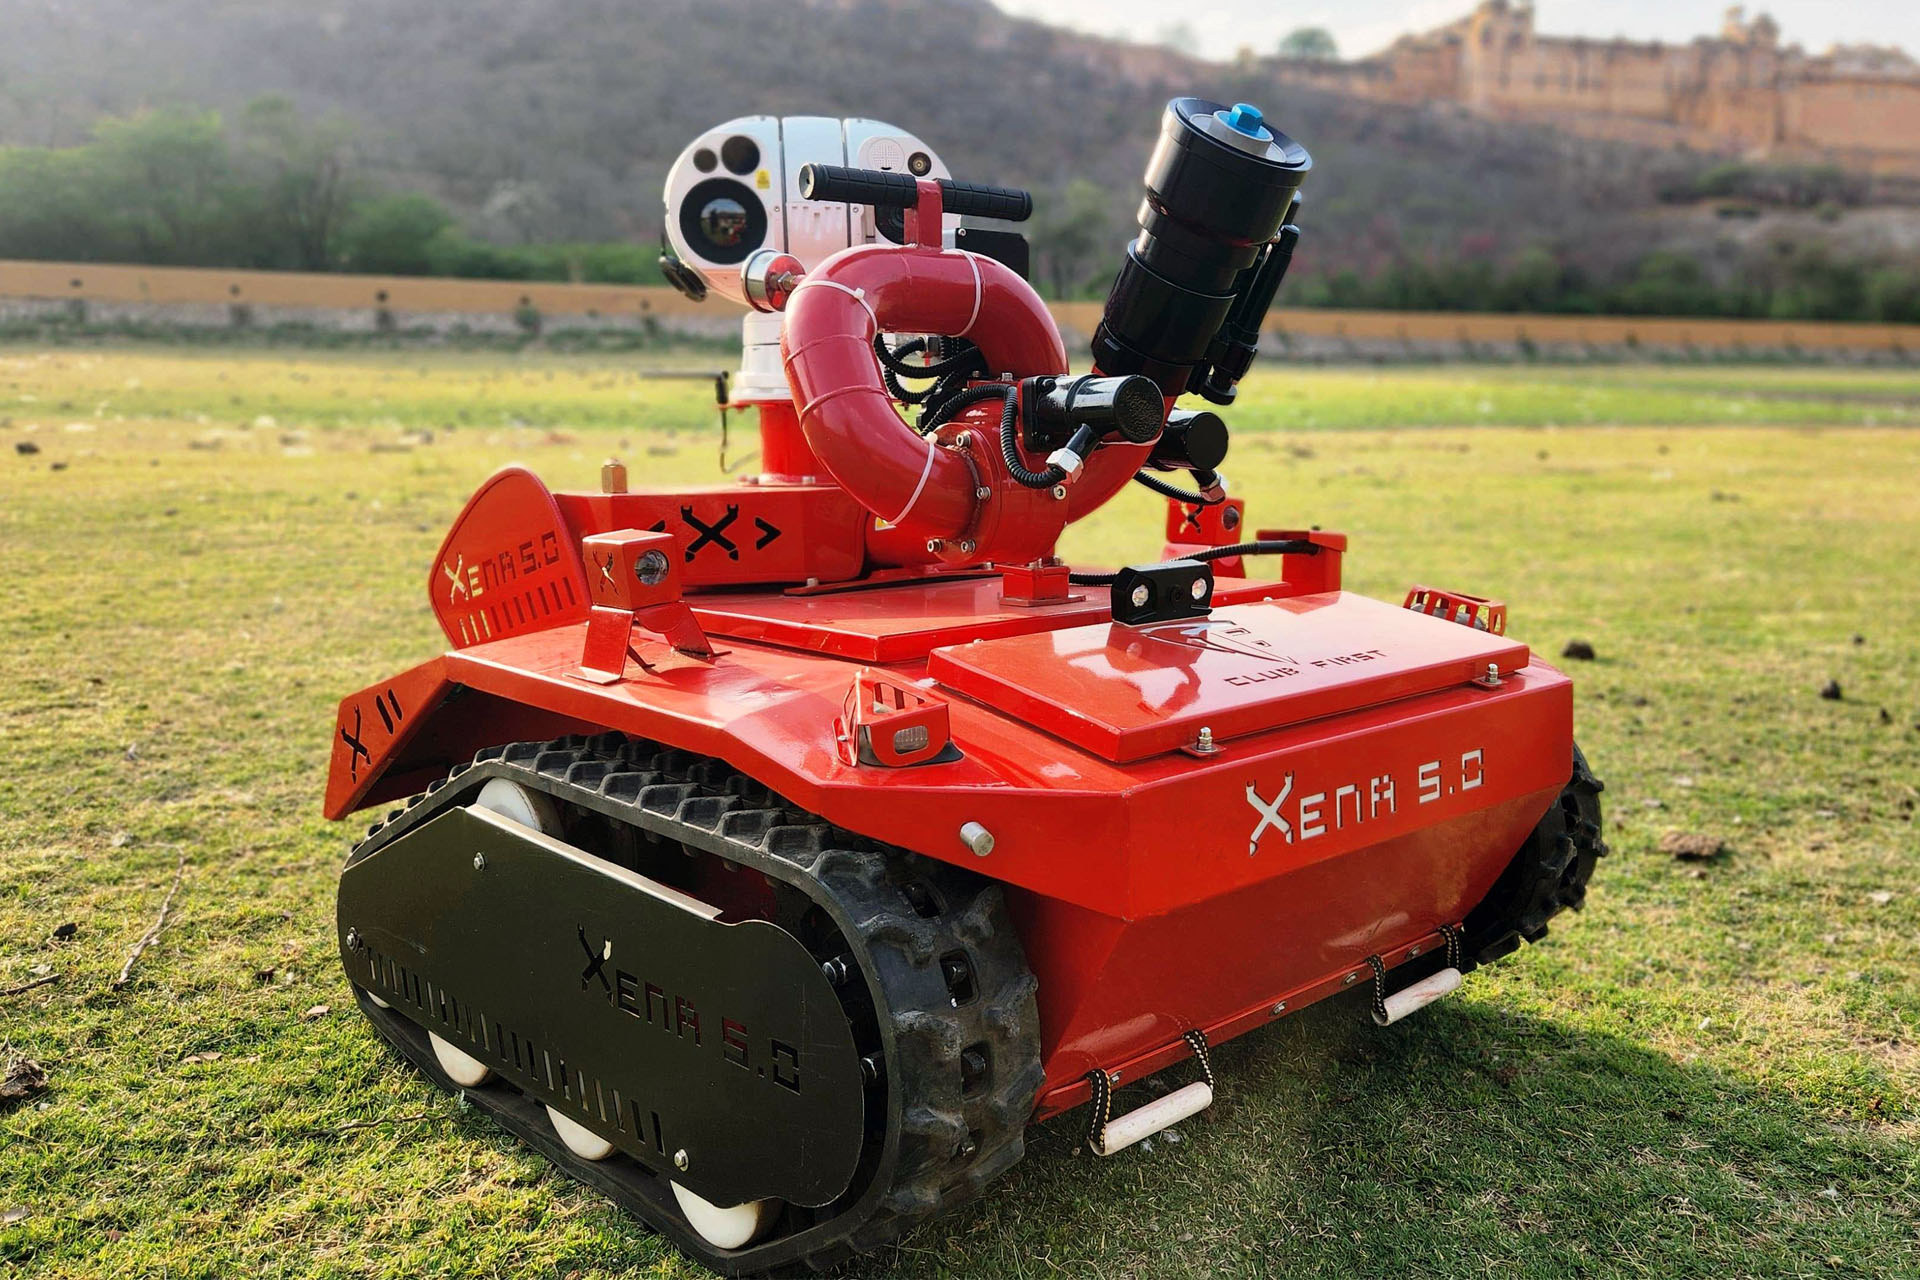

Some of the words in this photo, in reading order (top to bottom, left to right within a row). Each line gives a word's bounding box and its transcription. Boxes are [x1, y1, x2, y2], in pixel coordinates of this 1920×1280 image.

[518, 531, 560, 575] 5.0
[1223, 667, 1300, 687] CLUB
[1310, 649, 1387, 669] FIRST
[1418, 748, 1485, 804] 5.0
[721, 1016, 801, 1096] 5.0
